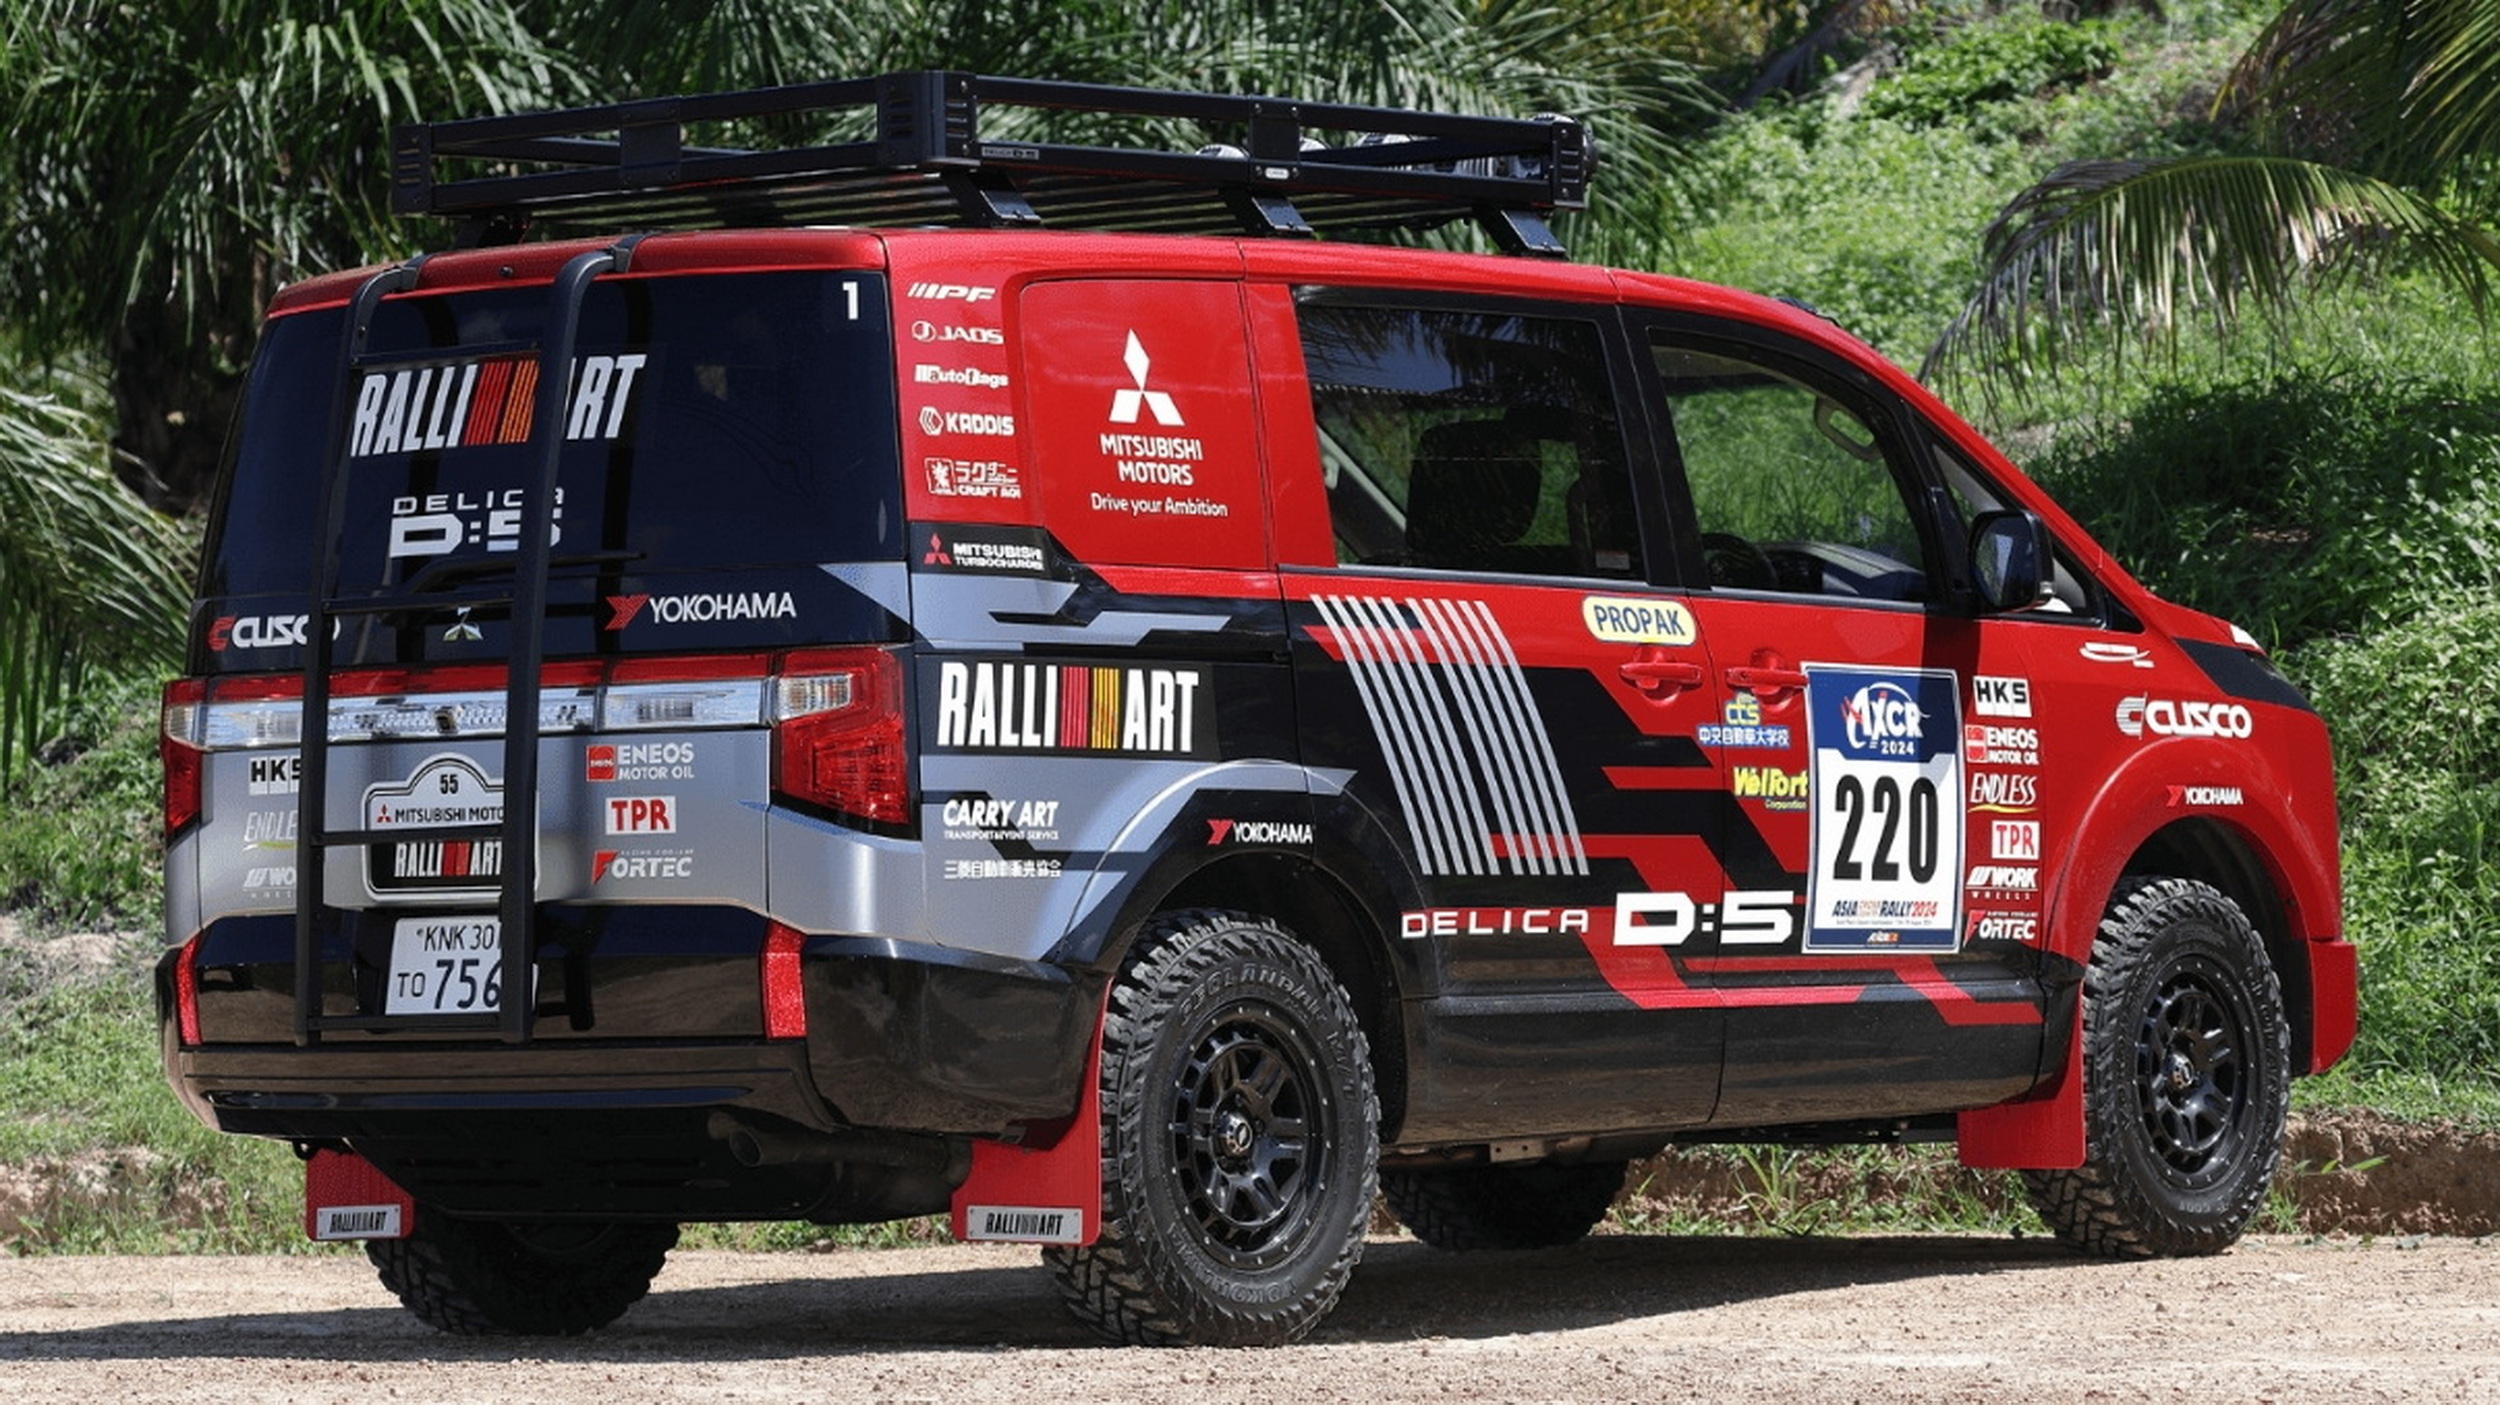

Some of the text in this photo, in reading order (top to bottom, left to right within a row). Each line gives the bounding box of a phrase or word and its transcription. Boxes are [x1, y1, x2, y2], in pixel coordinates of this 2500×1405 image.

[842, 281, 858, 320] 1
[937, 325, 1004, 344] JAOS
[1100, 433, 1204, 460] MITSUBISHI
[1117, 460, 1194, 485] MOTORS
[1090, 492, 1229, 517] Drive your Ambition
[952, 542, 1043, 561] MITSUBISHI
[648, 592, 797, 624] YOKOHAMA
[1593, 603, 1686, 638] PROPAK
[231, 614, 341, 649] CUSC
[1976, 680, 2027, 704] HKS
[2145, 700, 2252, 739] CUSCO
[1881, 739, 1915, 756] 2024
[1986, 726, 2039, 750] ENEOS
[617, 742, 695, 765] ENEOS
[440, 774, 459, 795] 55
[617, 765, 695, 781] MOTOR OIL
[1970, 772, 2037, 805] ENDLESS
[2184, 786, 2244, 806] YOKOHAMA
[395, 806, 467, 823] MITSUBISHI
[611, 798, 671, 832] TPR
[943, 799, 1060, 827] CARRY ART
[1233, 821, 1313, 844] YOKOHAMA
[1832, 773, 1939, 884] 220
[1995, 824, 2035, 850] TPR
[1990, 866, 2039, 888] WORK
[1402, 890, 1794, 946] DELICA D:5
[424, 924, 502, 951] KNK 30
[397, 971, 426, 998] TO
